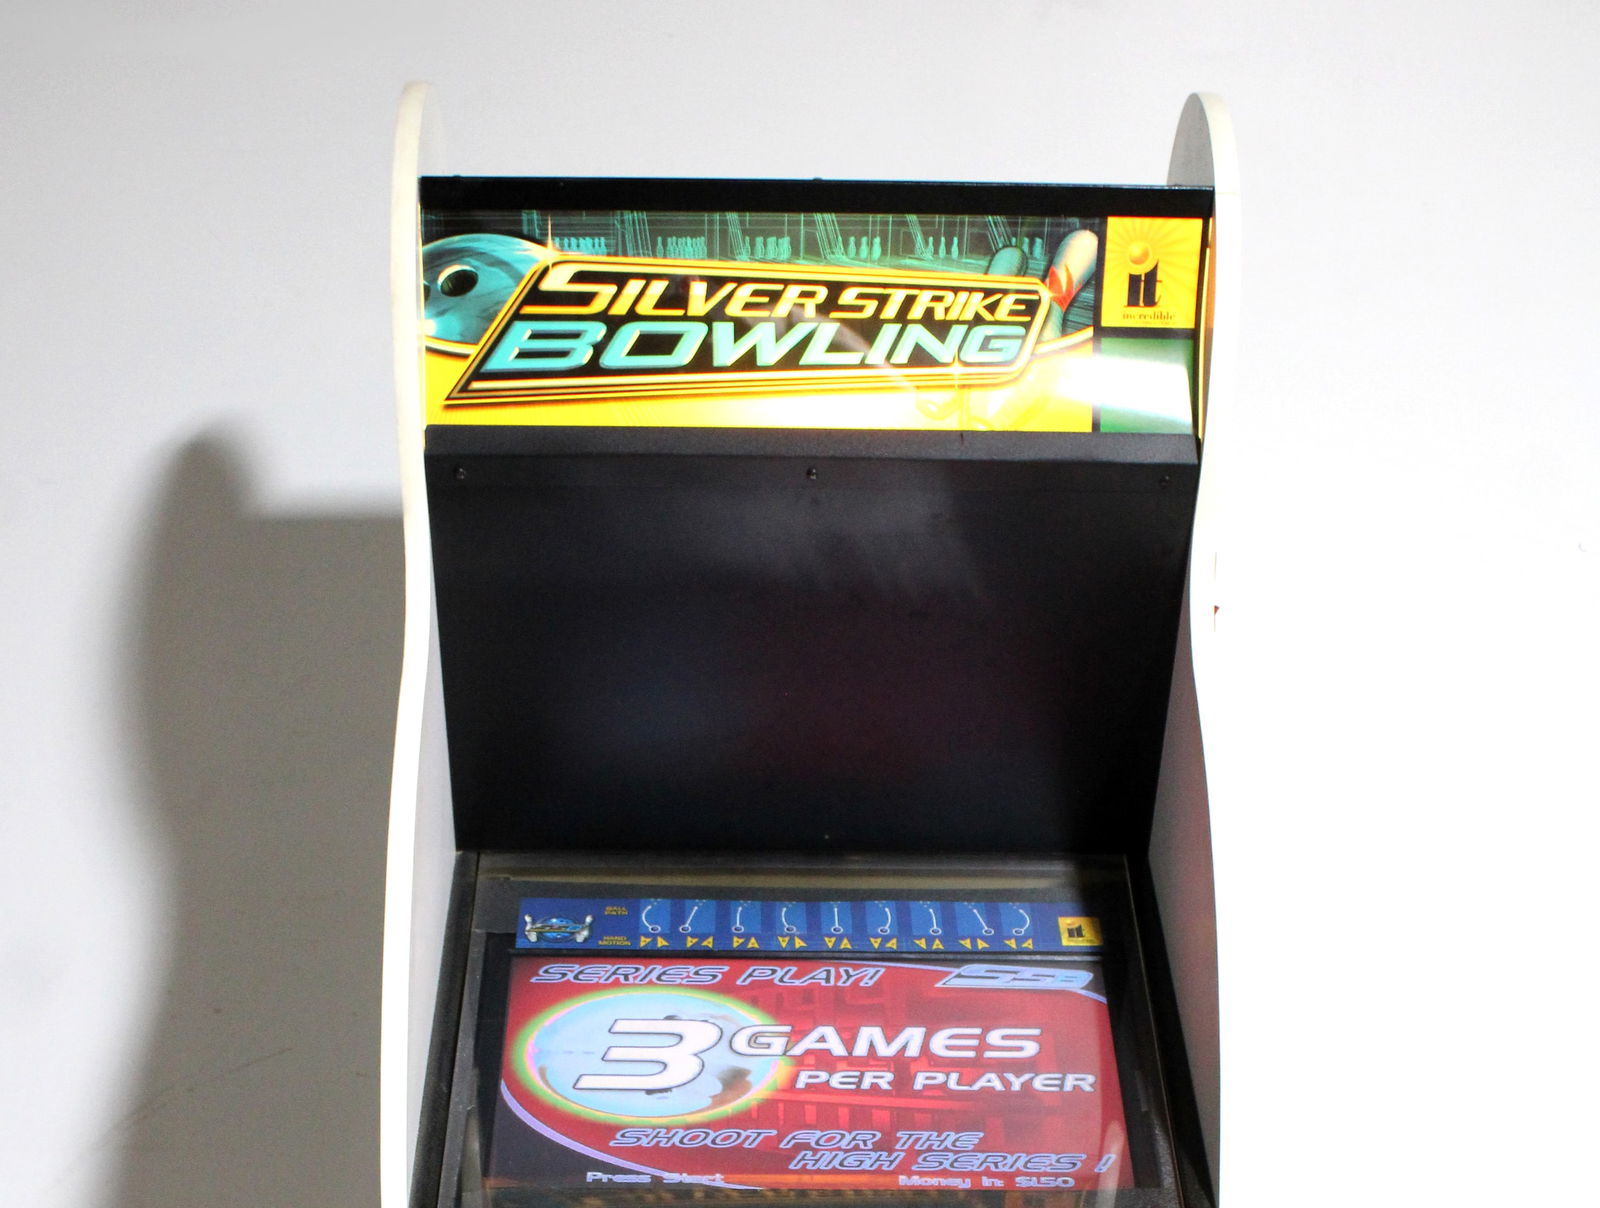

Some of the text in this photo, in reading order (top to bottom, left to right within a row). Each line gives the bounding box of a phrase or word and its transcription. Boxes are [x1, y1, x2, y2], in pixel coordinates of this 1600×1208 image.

[519, 262, 1040, 322] SILVER STRIKE
[480, 320, 1027, 373] BOWLING
[530, 964, 886, 986] SERIES PLAY!
[573, 1019, 1042, 1090] 3 GAMES
[795, 1070, 1097, 1092] PER PLAYER
[609, 1128, 984, 1150] SHOOT FOR THE
[788, 1151, 904, 1171] HIGH
[911, 1153, 1087, 1172] SERIES
[586, 1172, 652, 1183] Press
[899, 1175, 971, 1188] Money
